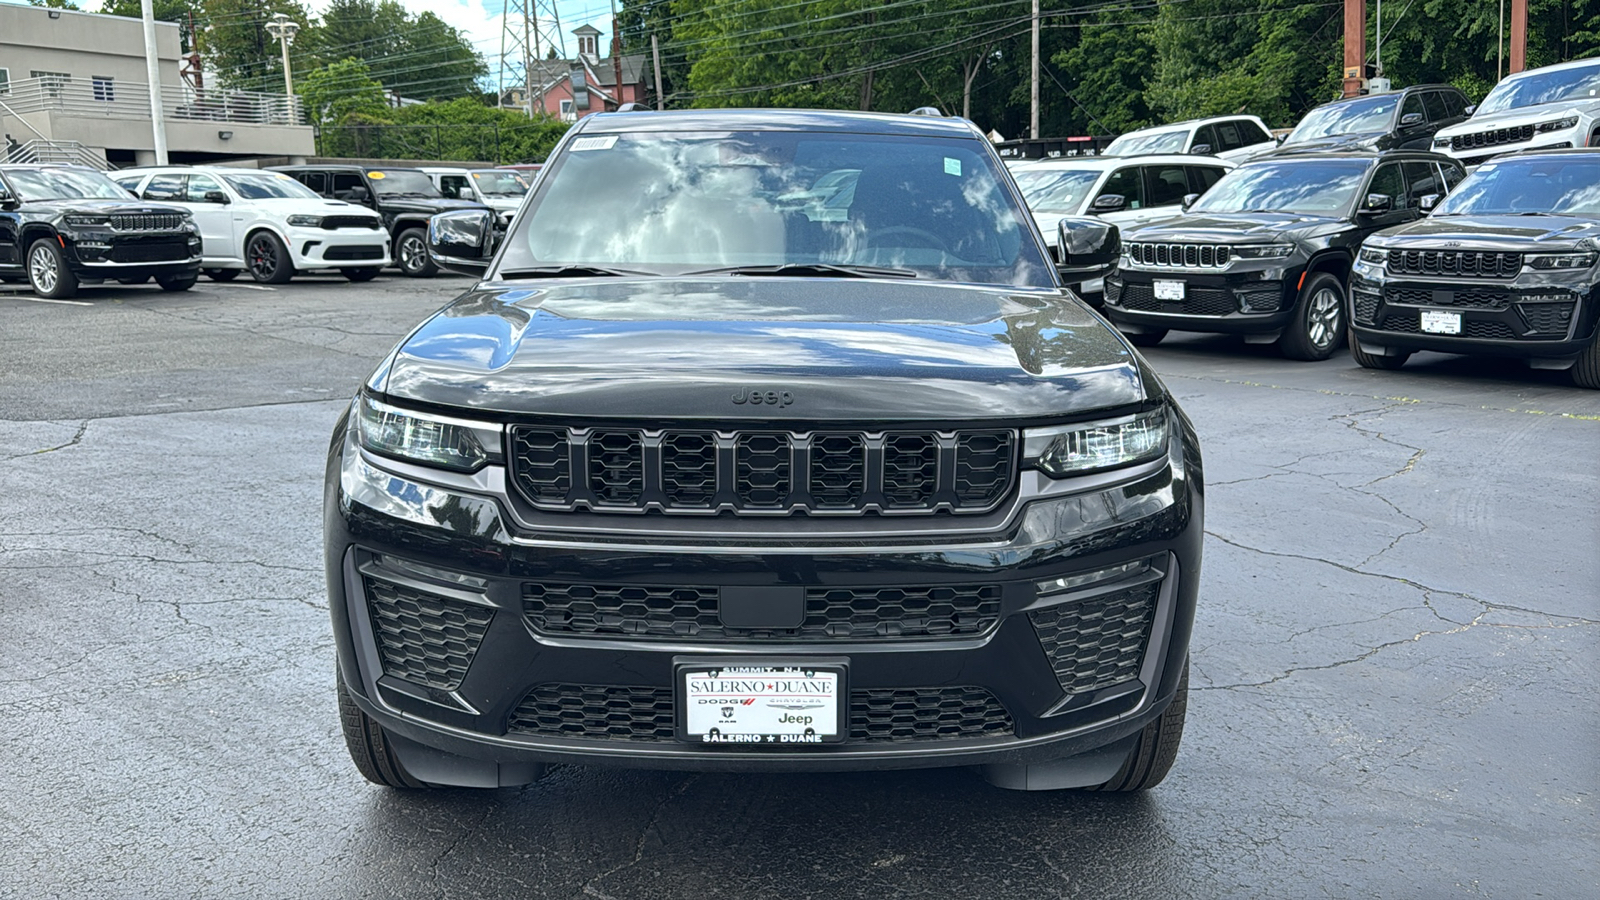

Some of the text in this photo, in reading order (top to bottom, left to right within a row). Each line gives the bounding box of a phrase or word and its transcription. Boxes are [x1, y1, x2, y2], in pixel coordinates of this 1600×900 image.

[731, 386, 794, 408] Jeep
[690, 681, 832, 693] SALERNO DUANE
[778, 713, 813, 726] Jeep
